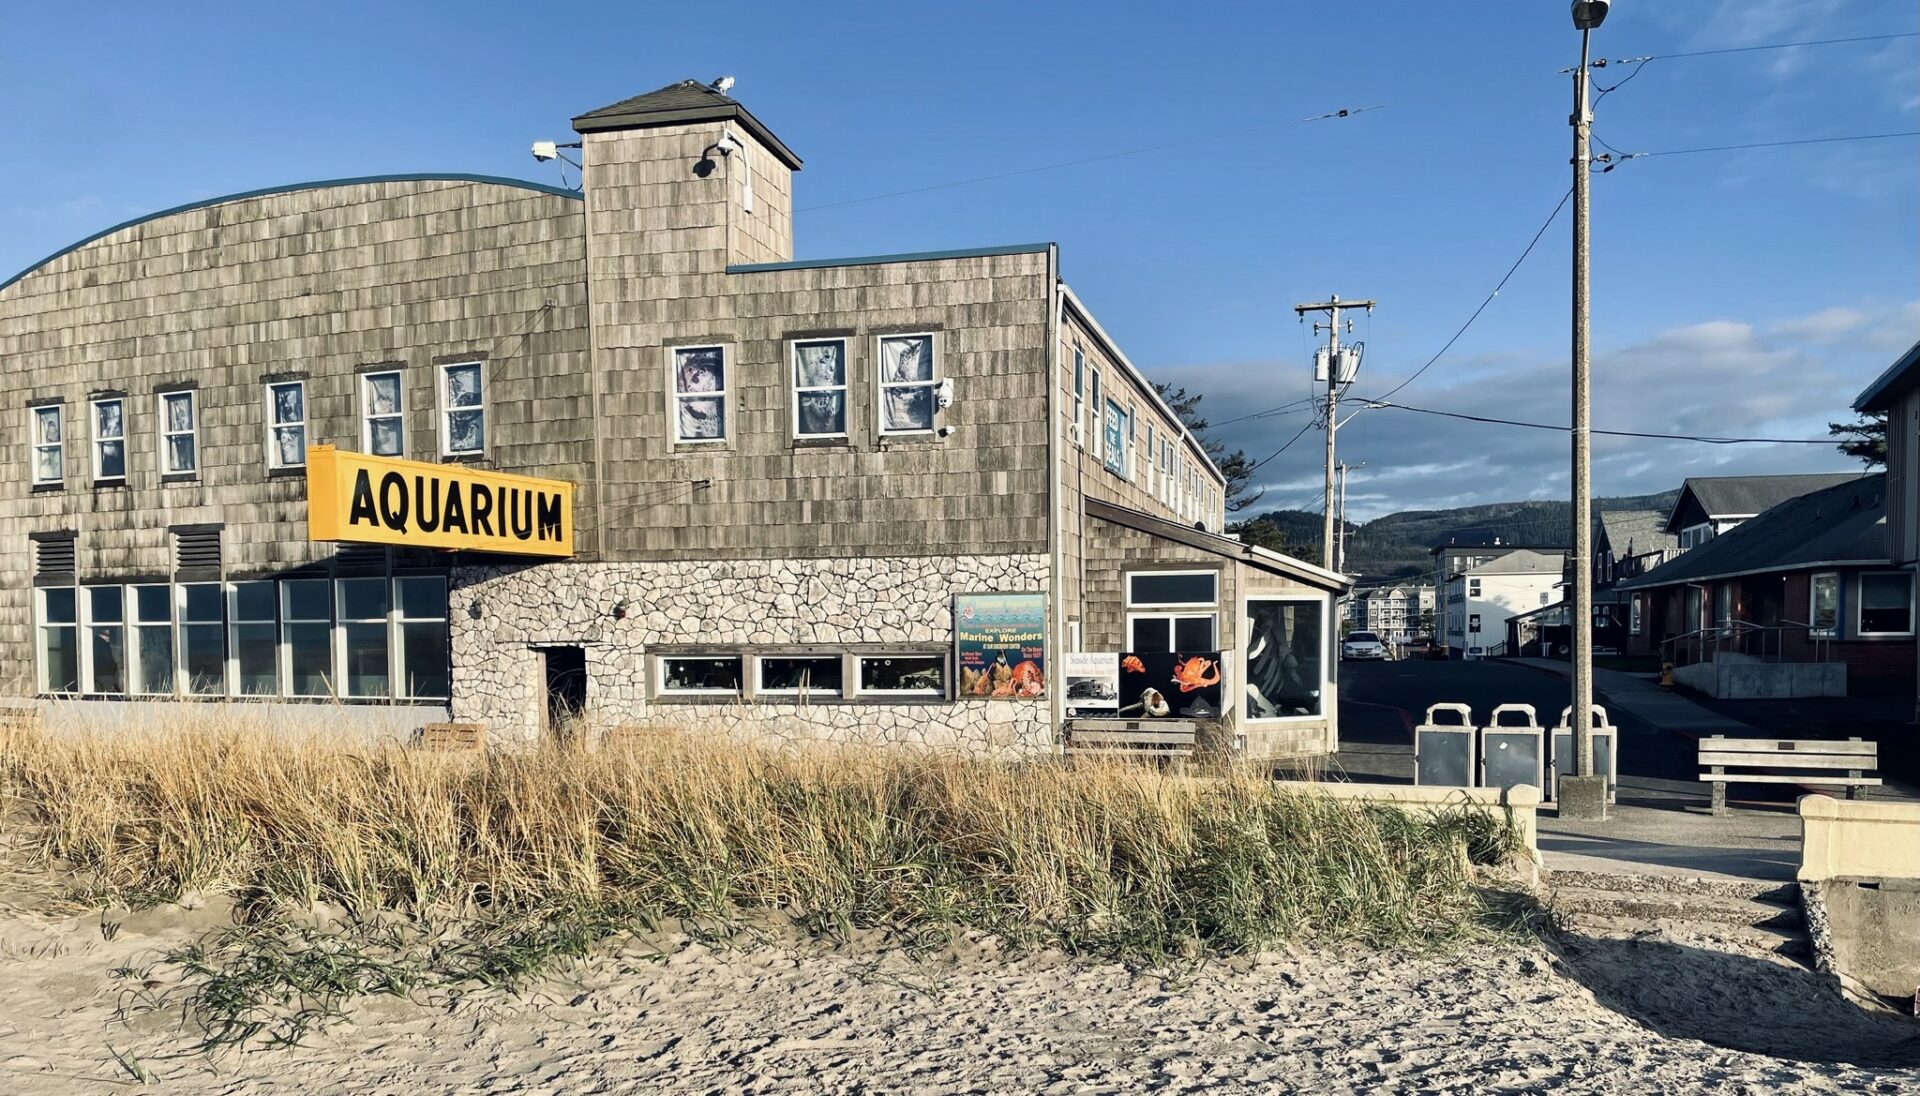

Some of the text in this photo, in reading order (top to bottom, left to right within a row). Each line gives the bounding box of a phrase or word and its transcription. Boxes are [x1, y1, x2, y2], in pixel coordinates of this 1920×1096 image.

[349, 468, 562, 542] AQUARIUM
[960, 631, 1043, 643] Marine Wonders
[1070, 654, 1115, 667] Seaside Aquarium
